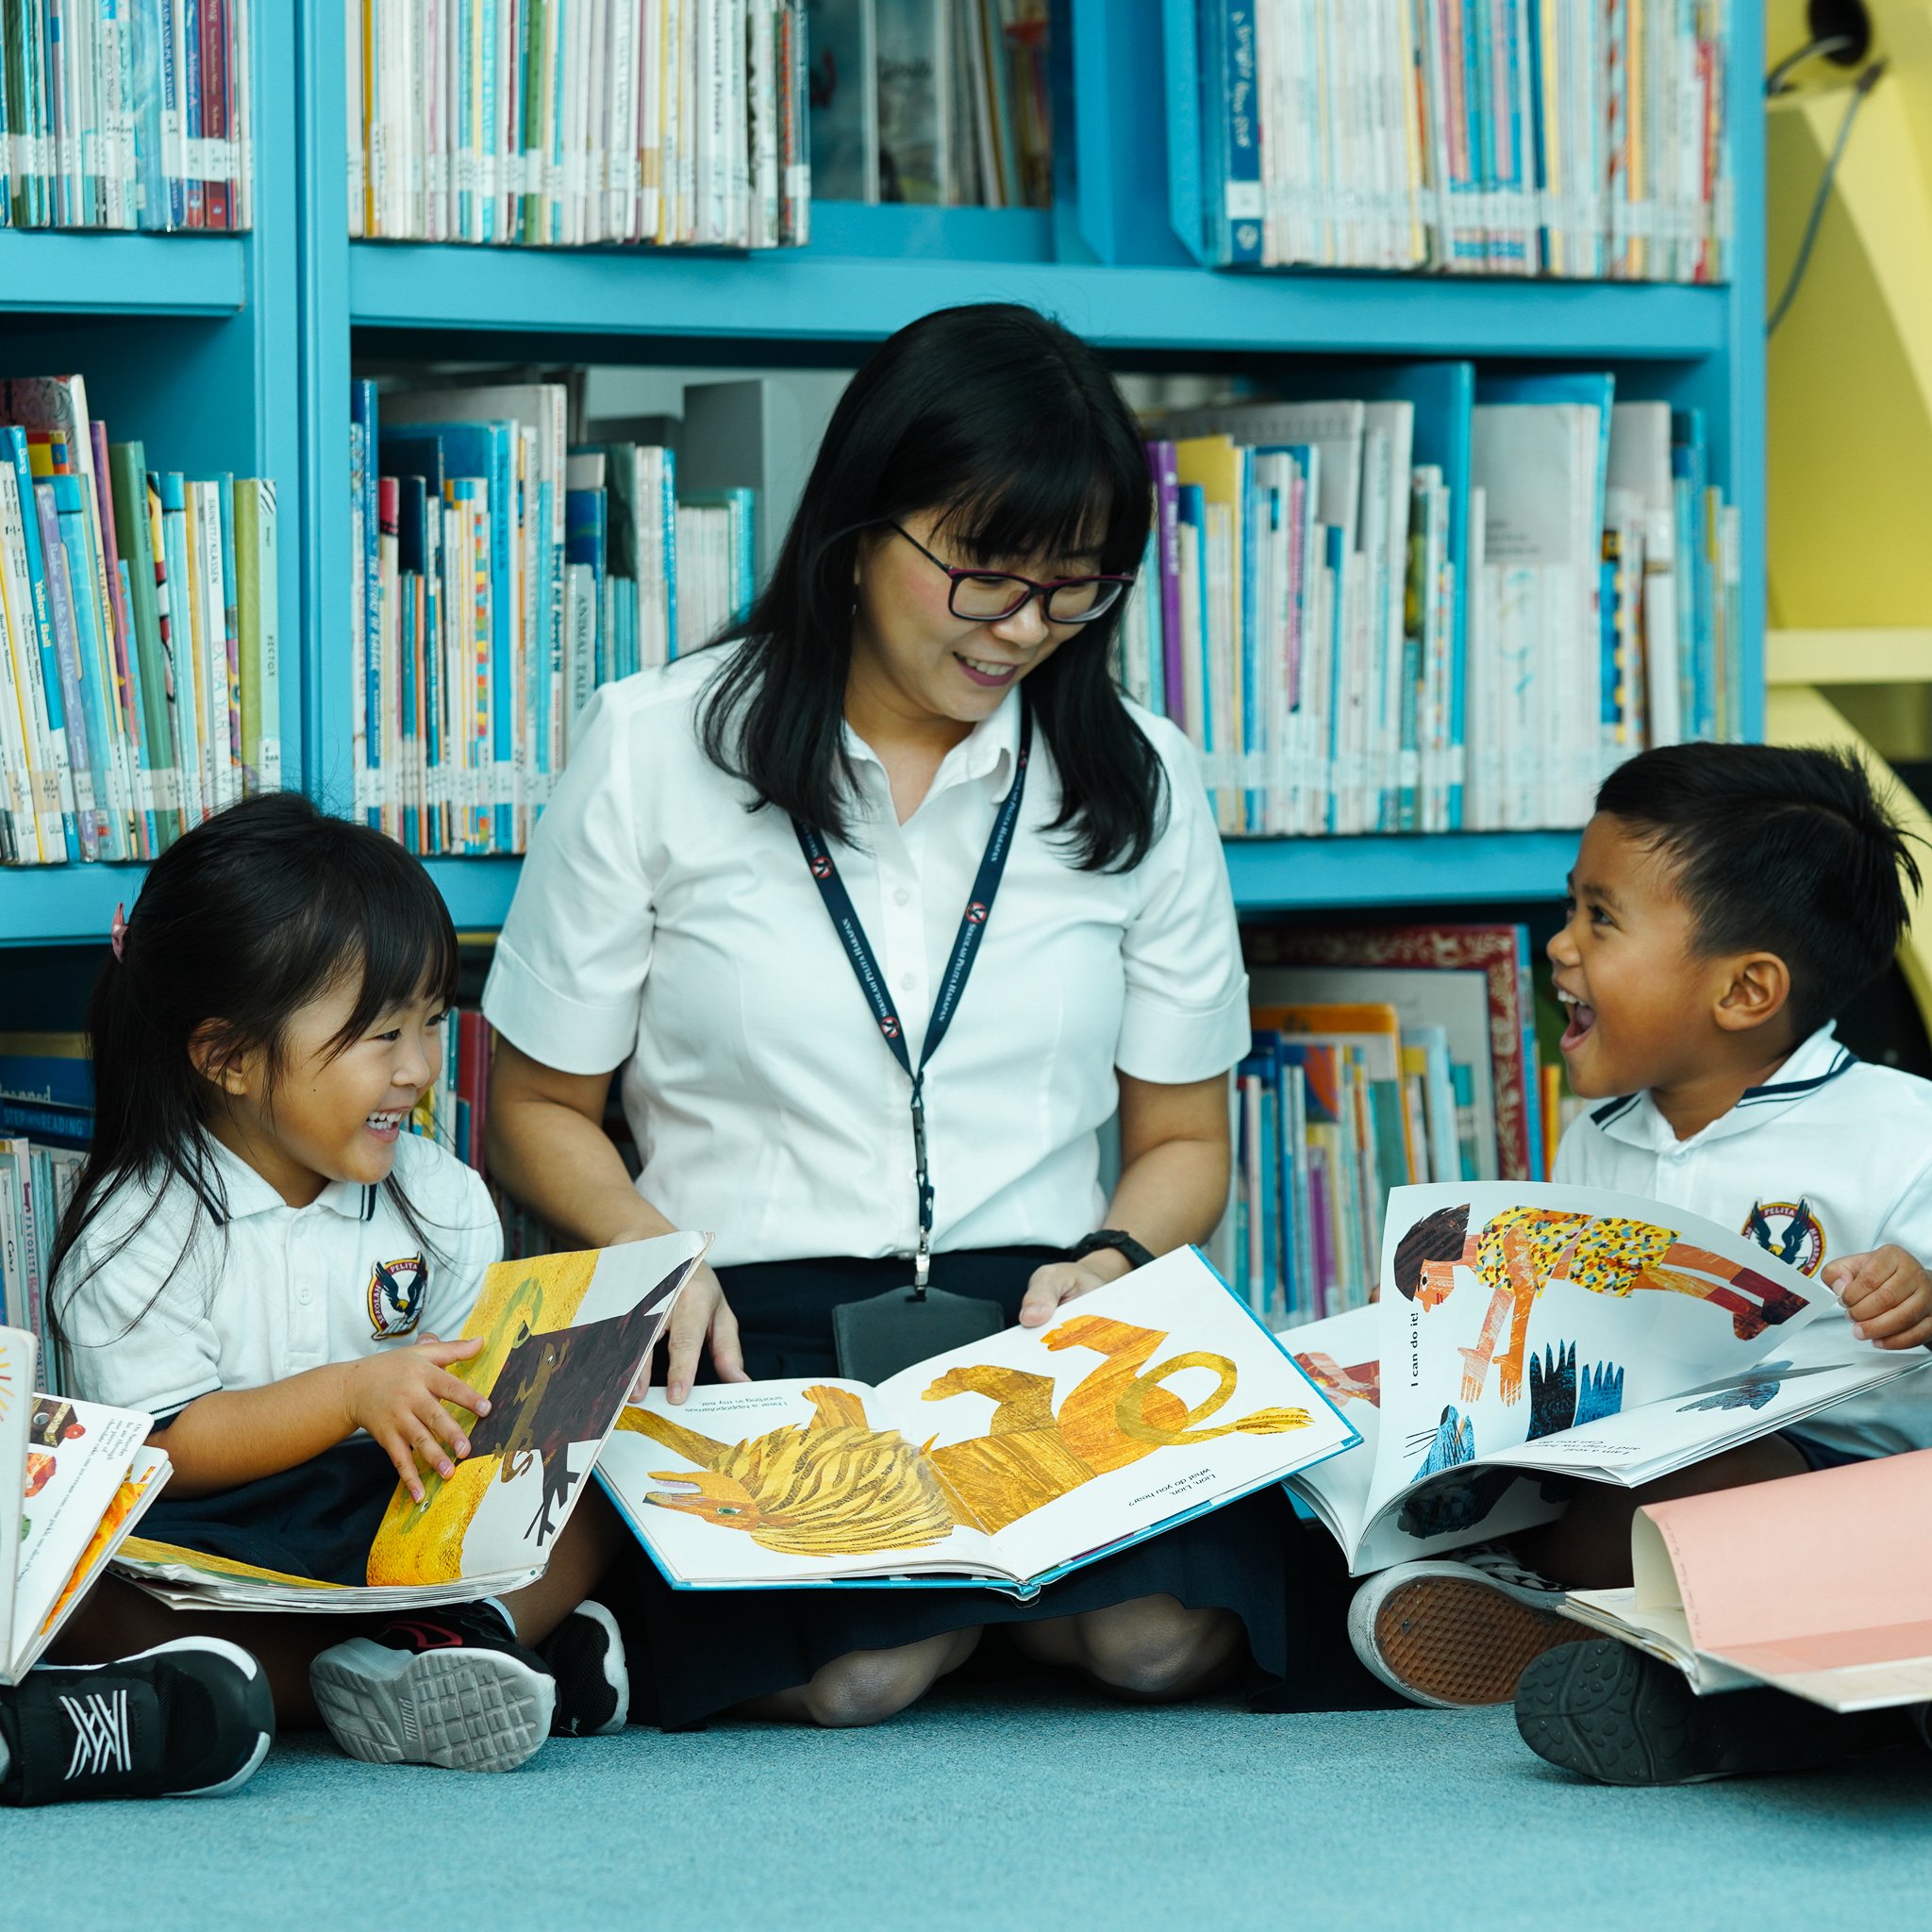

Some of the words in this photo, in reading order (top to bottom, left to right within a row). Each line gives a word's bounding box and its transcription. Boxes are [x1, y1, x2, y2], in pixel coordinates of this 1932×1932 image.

[17, 447, 27, 475] Bang
[49, 543, 59, 578] Barbie
[35, 580, 50, 623] Yellow
[41, 623, 52, 649] Ball
[575, 595, 590, 656] ANIMAL
[213, 641, 226, 696] EXTRA
[575, 663, 589, 710] TALES
[214, 699, 228, 741] YARN
[841, 918, 863, 956] HARAPAN
[858, 955, 874, 982] PELITA
[951, 958, 966, 987] PELITA
[868, 980, 890, 1017] SEKOLAH
[41, 1113, 83, 1138] READING
[1763, 1207, 1795, 1216] PELITA
[7, 1240, 15, 1274] Cars
[25, 1216, 36, 1275] FAVORITE
[390, 1262, 418, 1273] PELITA
[373, 1284, 386, 1324] SEKOLAH
[1409, 1311, 1419, 1327] it!
[1410, 1331, 1419, 1349] do
[97, 1418, 114, 1443] chocolate
[107, 1439, 124, 1461] through
[1174, 1478, 1187, 1488] do
[1189, 1468, 1211, 1480] what
[1192, 1473, 1216, 1486] Lion,
[1128, 1492, 1155, 1507] hear?
[1156, 1484, 1173, 1494] you
[1168, 1485, 1192, 1497] Lion,
